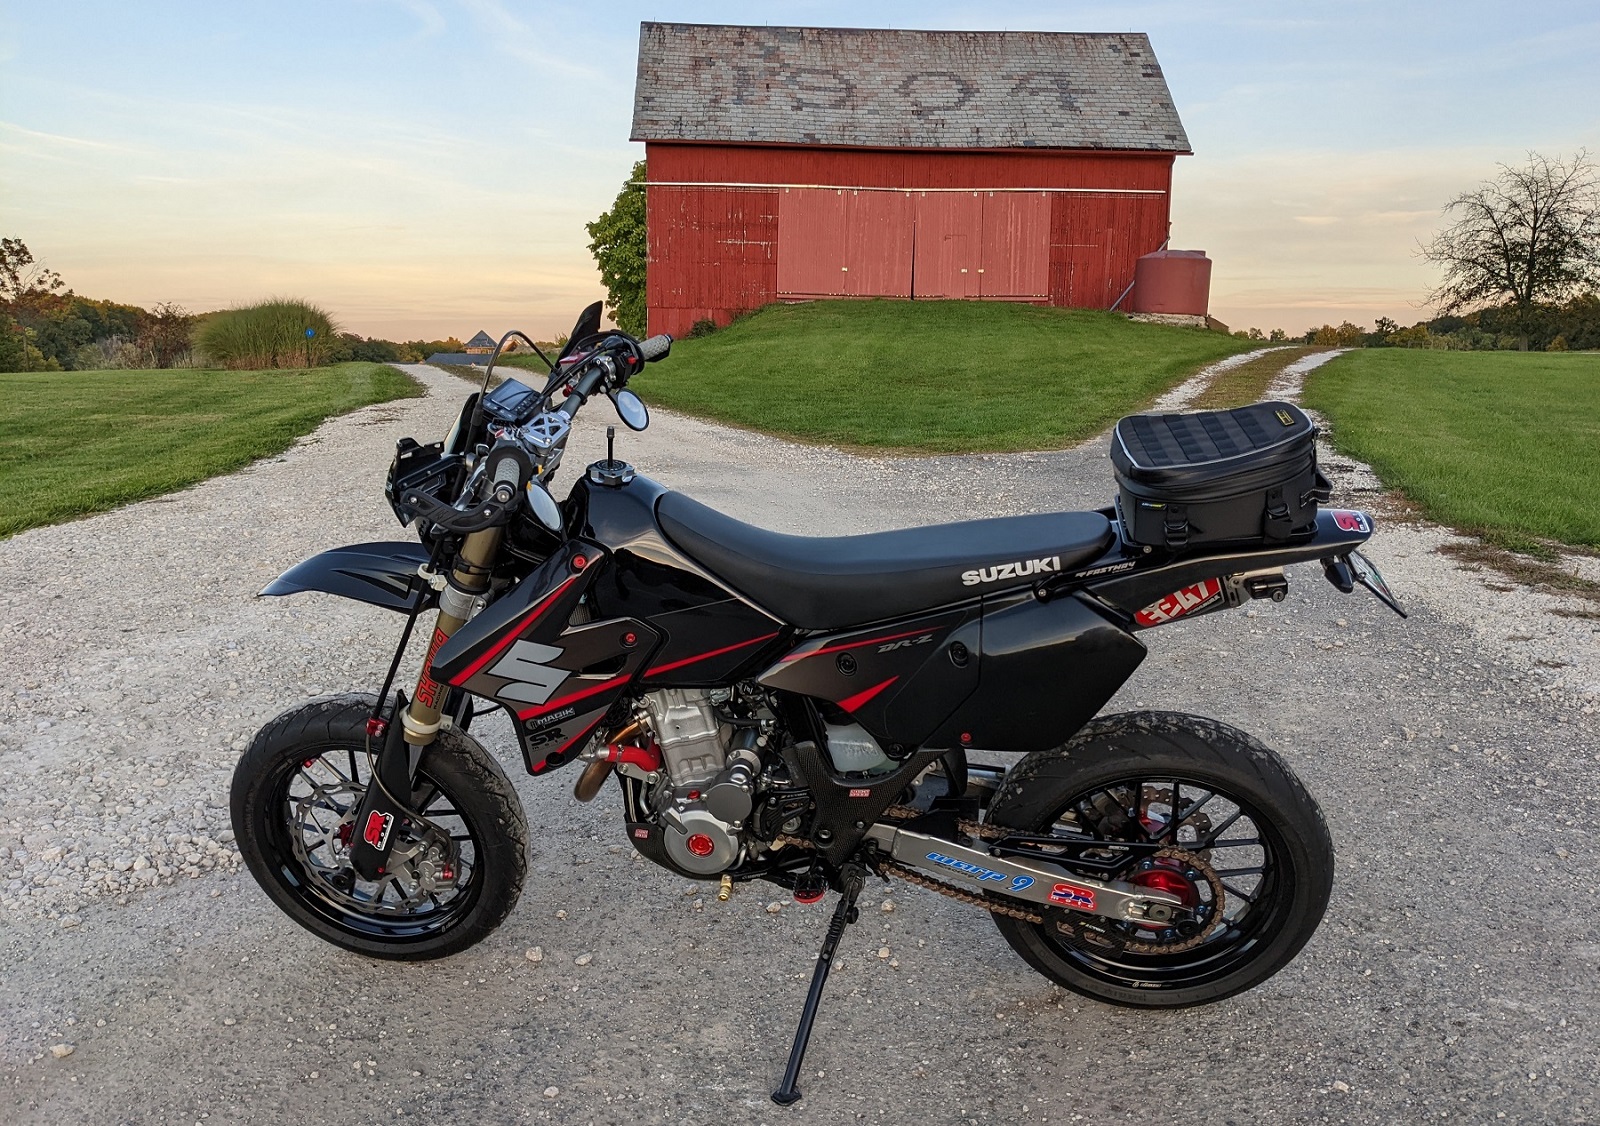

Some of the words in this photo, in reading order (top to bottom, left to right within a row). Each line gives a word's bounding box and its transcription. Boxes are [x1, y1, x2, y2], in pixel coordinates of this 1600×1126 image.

[961, 556, 1061, 586] SUZUKI
[877, 633, 934, 654] DR-Z
[529, 728, 566, 747] SR
[364, 811, 385, 846] SR
[1009, 875, 1035, 892] 9
[1051, 883, 1094, 904] SR
